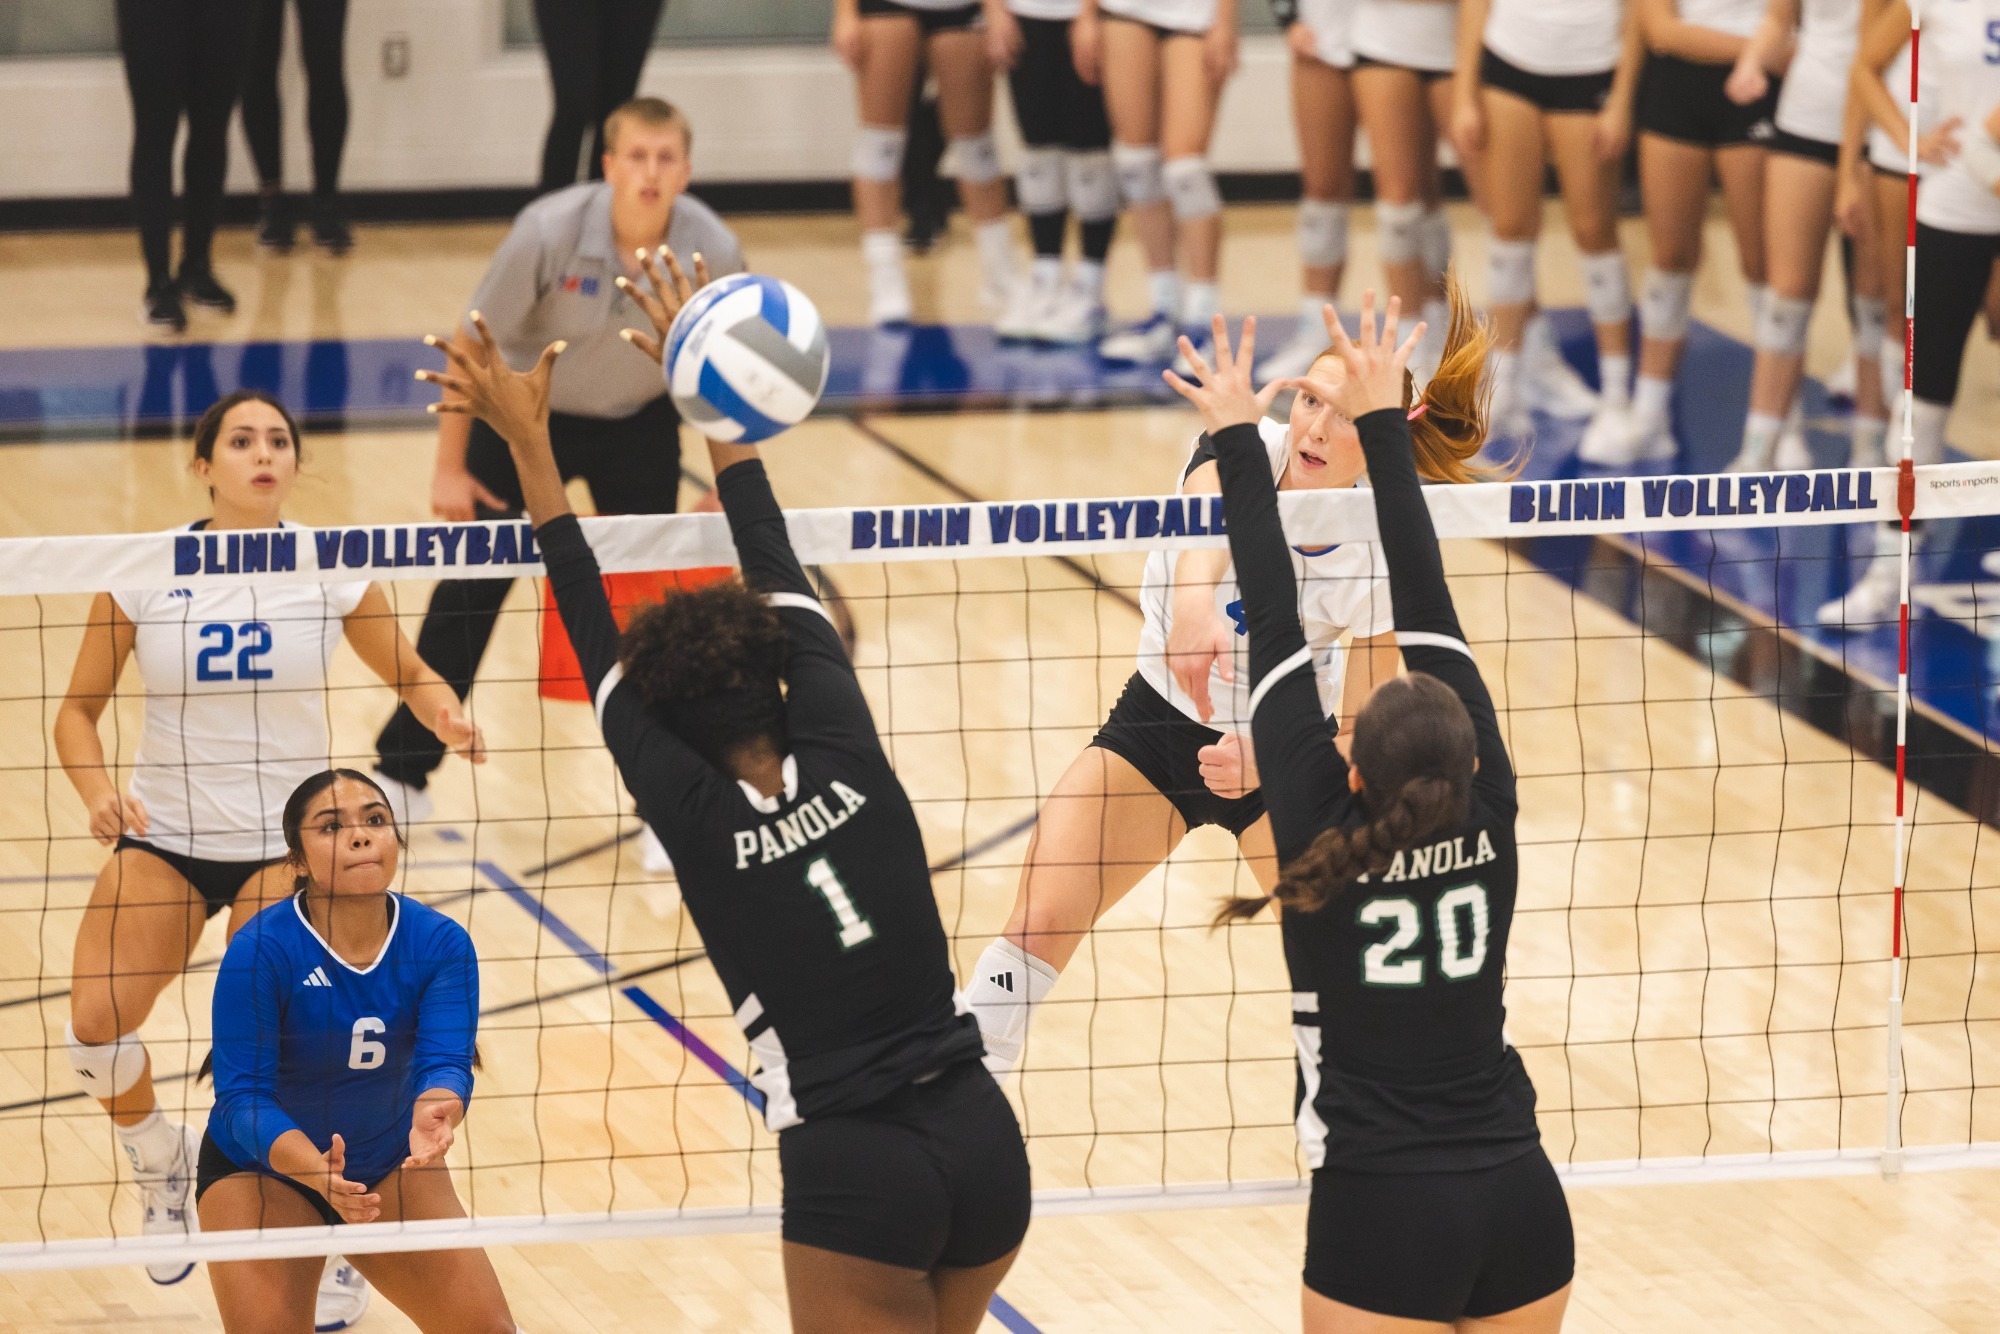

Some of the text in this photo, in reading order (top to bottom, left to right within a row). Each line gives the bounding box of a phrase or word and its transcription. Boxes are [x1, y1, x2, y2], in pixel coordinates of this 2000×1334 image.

[1509, 471, 1878, 523] BLINN VOLLEYBALL
[1929, 475, 1999, 490] sports imports
[174, 524, 542, 576] BLINN VOLLEYBAL
[851, 496, 1228, 550] BLINN VOLLEYBALL
[196, 621, 273, 682] 22
[733, 780, 867, 870] PANOLA
[1356, 829, 1497, 884] ANOLA
[806, 855, 874, 949] 1
[1358, 882, 1490, 985] 20
[347, 1016, 387, 1070] 6
